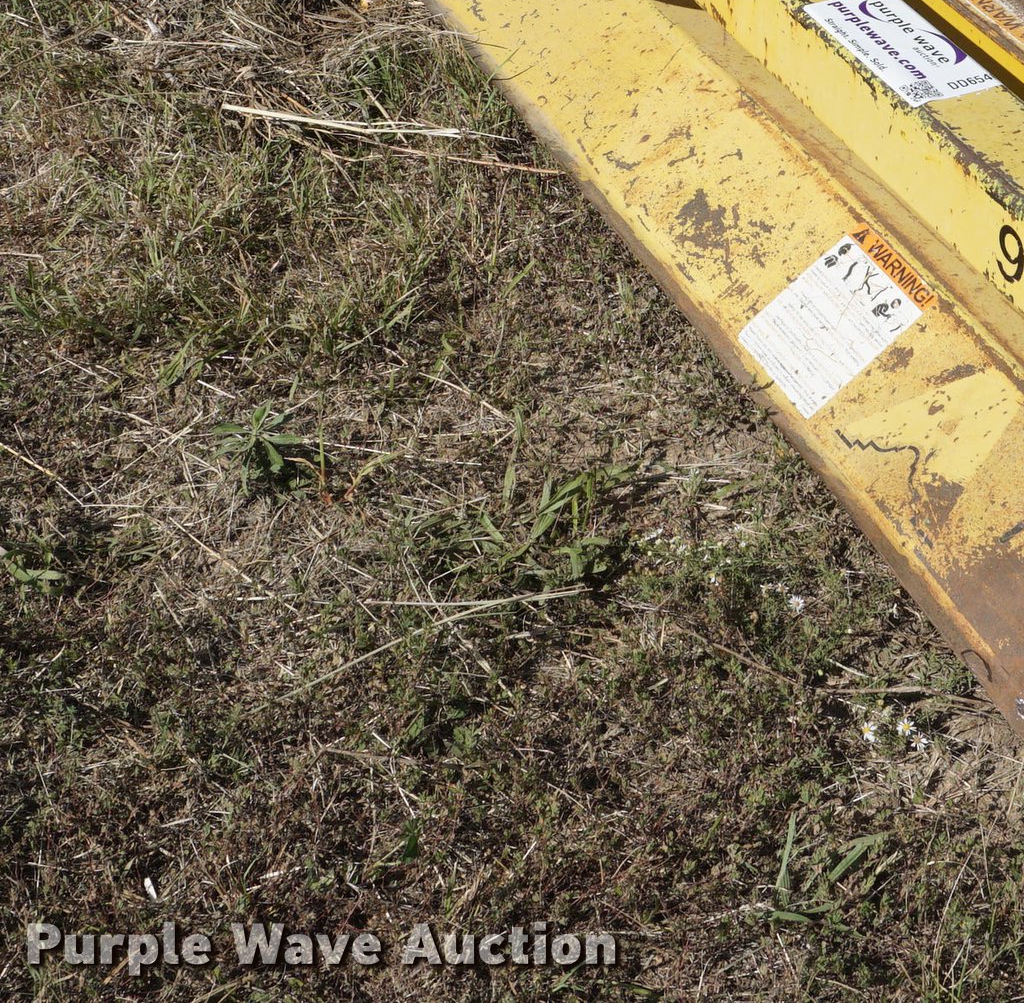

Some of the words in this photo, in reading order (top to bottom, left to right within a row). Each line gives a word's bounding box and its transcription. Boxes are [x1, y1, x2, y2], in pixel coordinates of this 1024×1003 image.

[827, 0, 927, 80] purplewave.com
[869, 0, 915, 34] purple
[913, 34, 950, 64] wave
[868, 238, 936, 309] WARNING!
